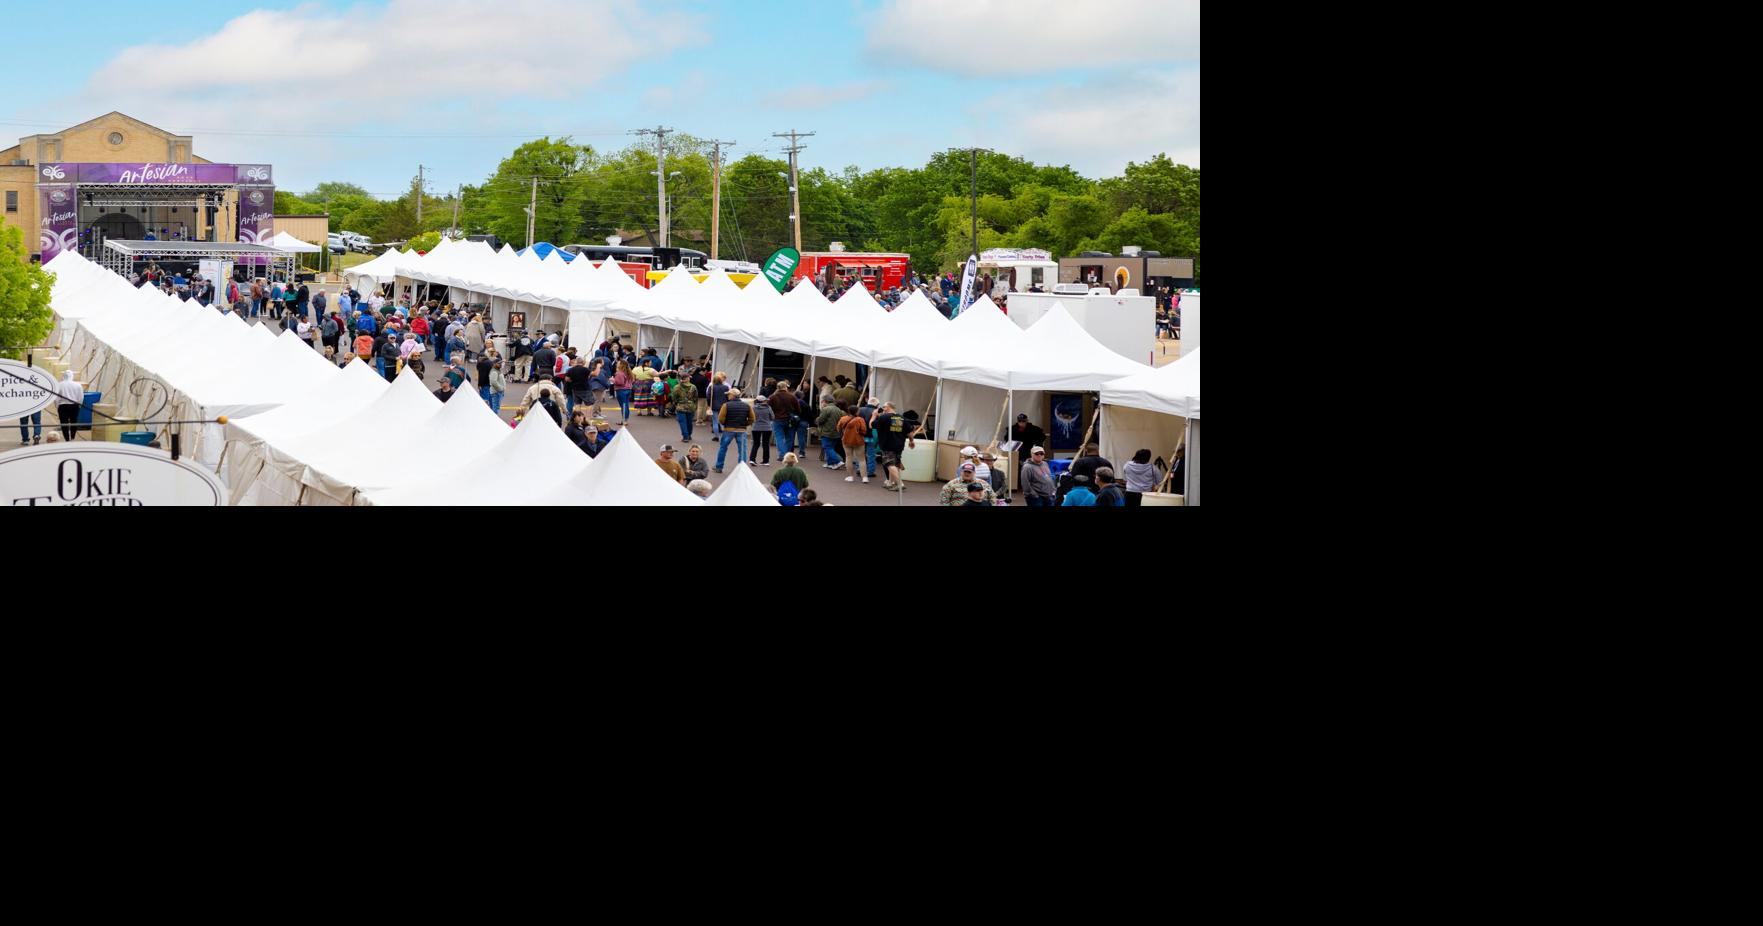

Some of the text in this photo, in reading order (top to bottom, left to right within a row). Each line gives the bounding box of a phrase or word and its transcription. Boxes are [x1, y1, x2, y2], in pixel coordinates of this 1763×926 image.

[119, 163, 188, 183] Artesian
[41, 212, 77, 226] Artesian
[240, 212, 273, 225] Artesian
[765, 253, 795, 283] ATM
[57, 458, 132, 501] OKIE
